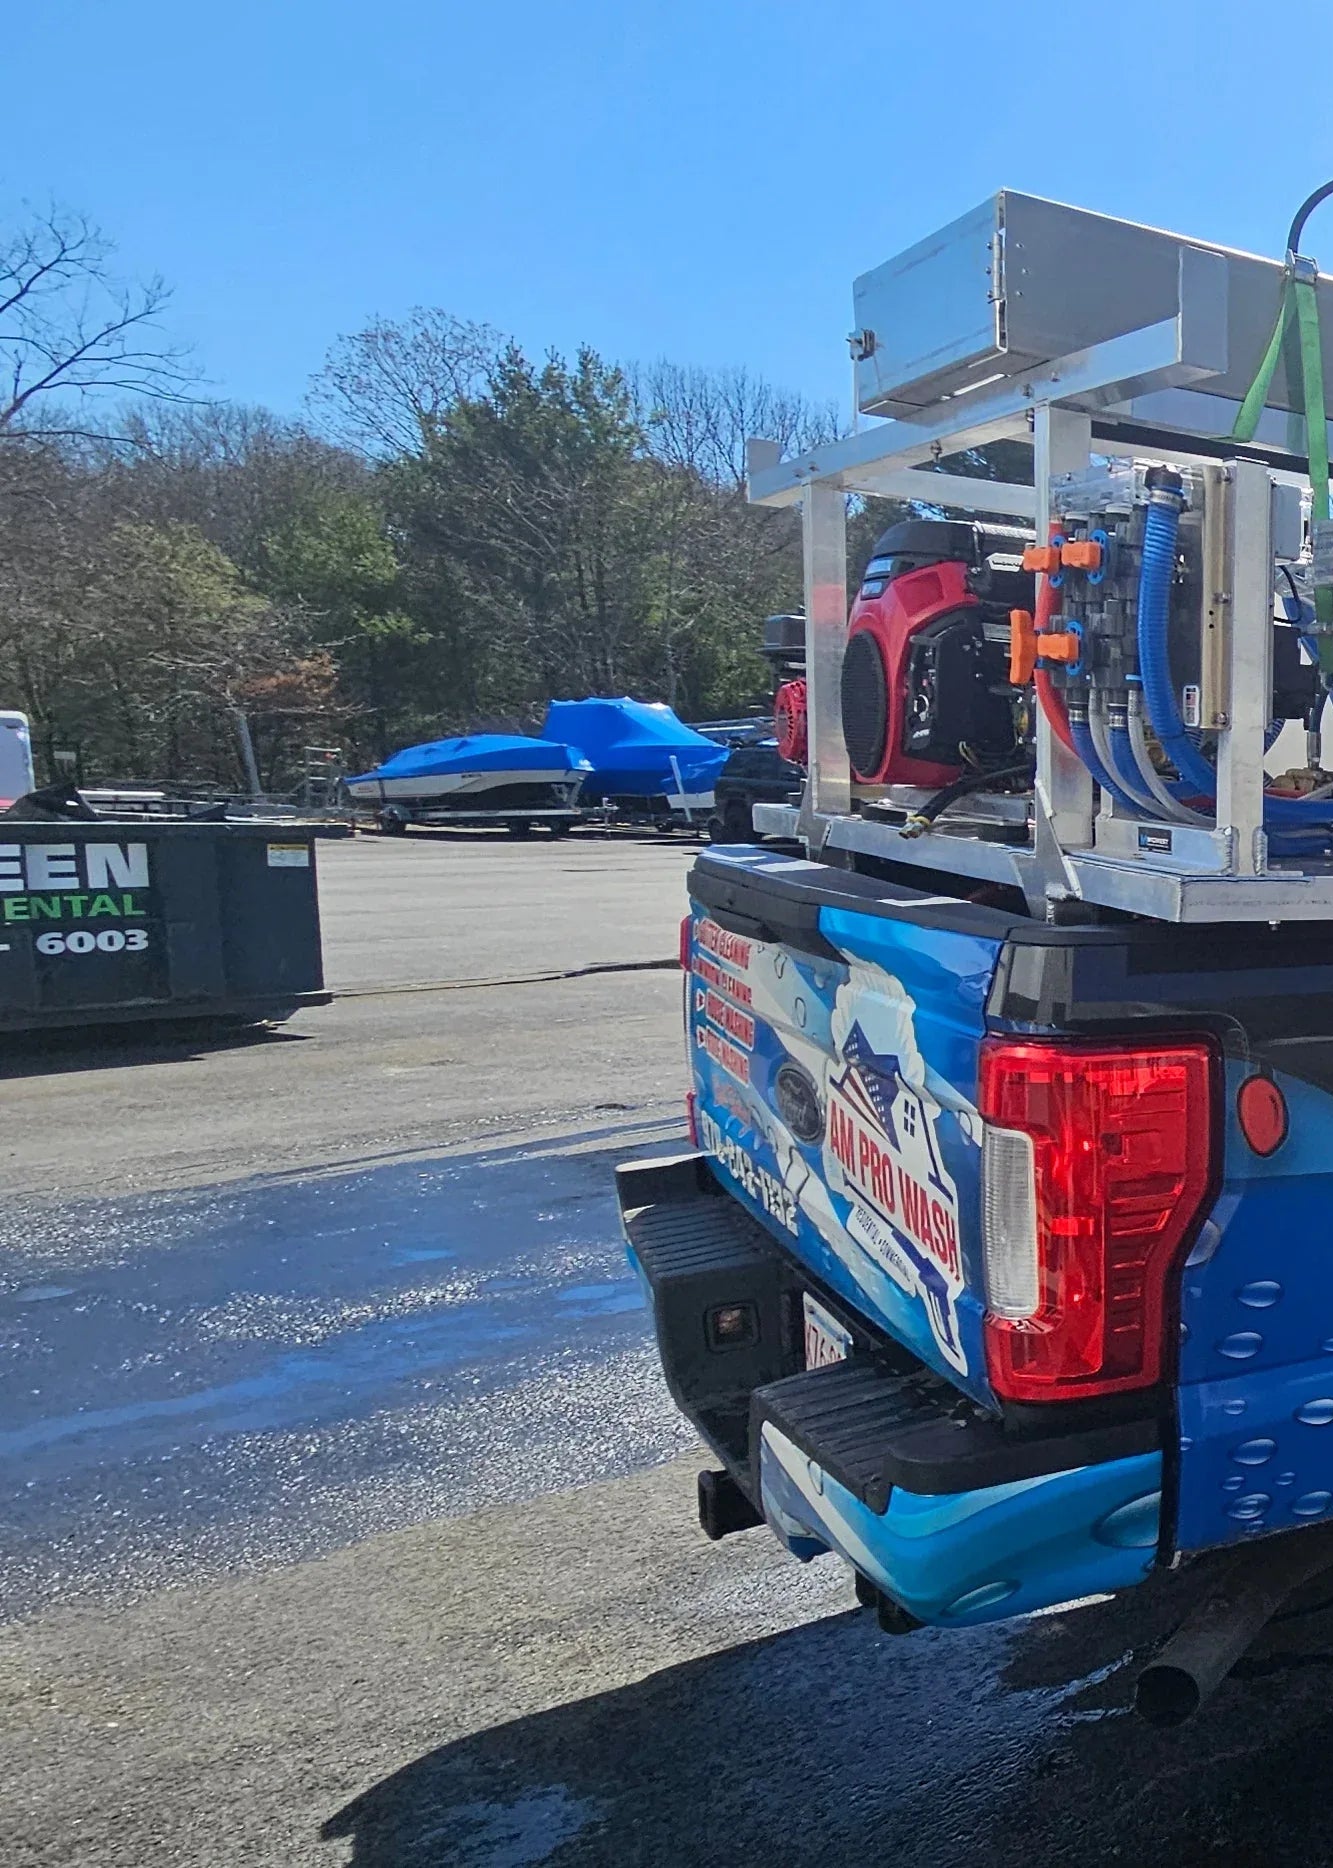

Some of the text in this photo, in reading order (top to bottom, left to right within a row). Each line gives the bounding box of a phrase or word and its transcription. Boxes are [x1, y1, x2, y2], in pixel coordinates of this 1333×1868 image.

[36, 928, 149, 955] 6003
[830, 1099, 856, 1177] AM
[859, 1129, 895, 1214] PRO
[898, 1165, 961, 1281] WASH
